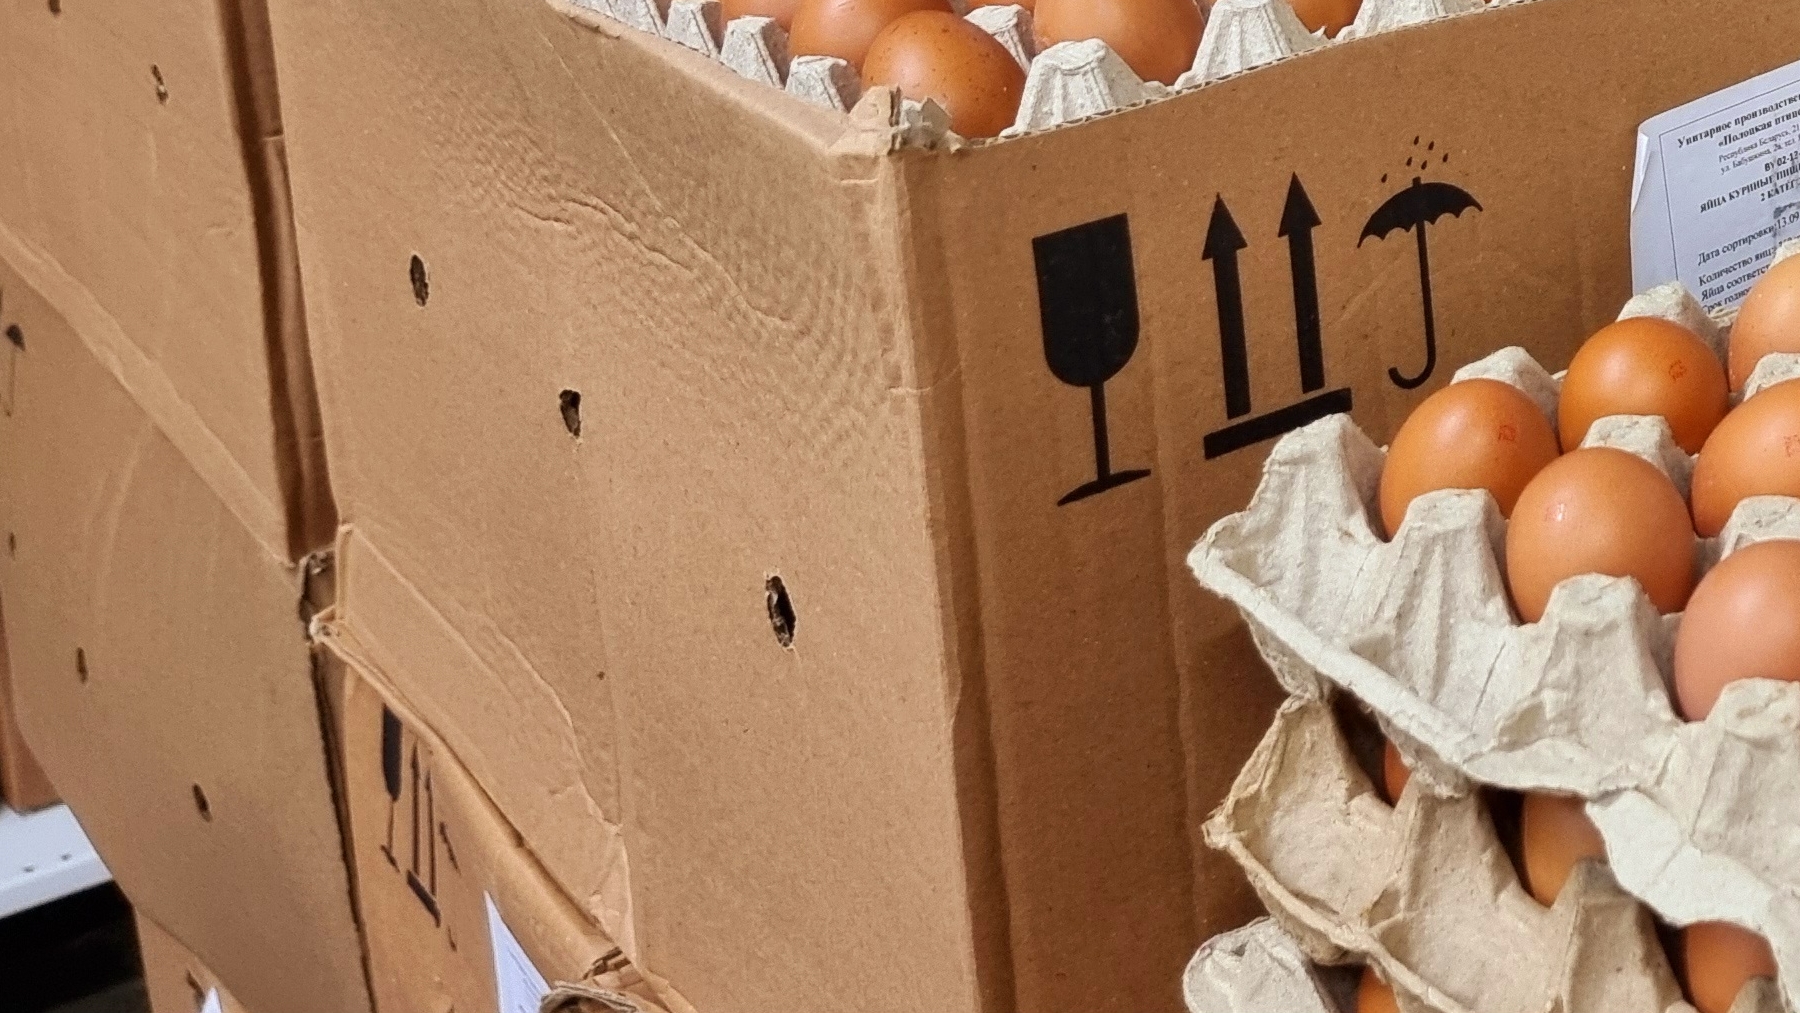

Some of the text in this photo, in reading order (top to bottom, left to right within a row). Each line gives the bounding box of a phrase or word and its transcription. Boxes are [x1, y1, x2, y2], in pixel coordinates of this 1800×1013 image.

[1677, 120, 1732, 148] Унитарное
[1700, 195, 1727, 213] ЯЙЦА
[1728, 175, 1773, 200] КУРИНЫЕ
[1698, 248, 1720, 266] Дата
[1698, 256, 1753, 287] Количество
[1701, 263, 1771, 302] Яйца соответст
[1724, 286, 1753, 305] годно
